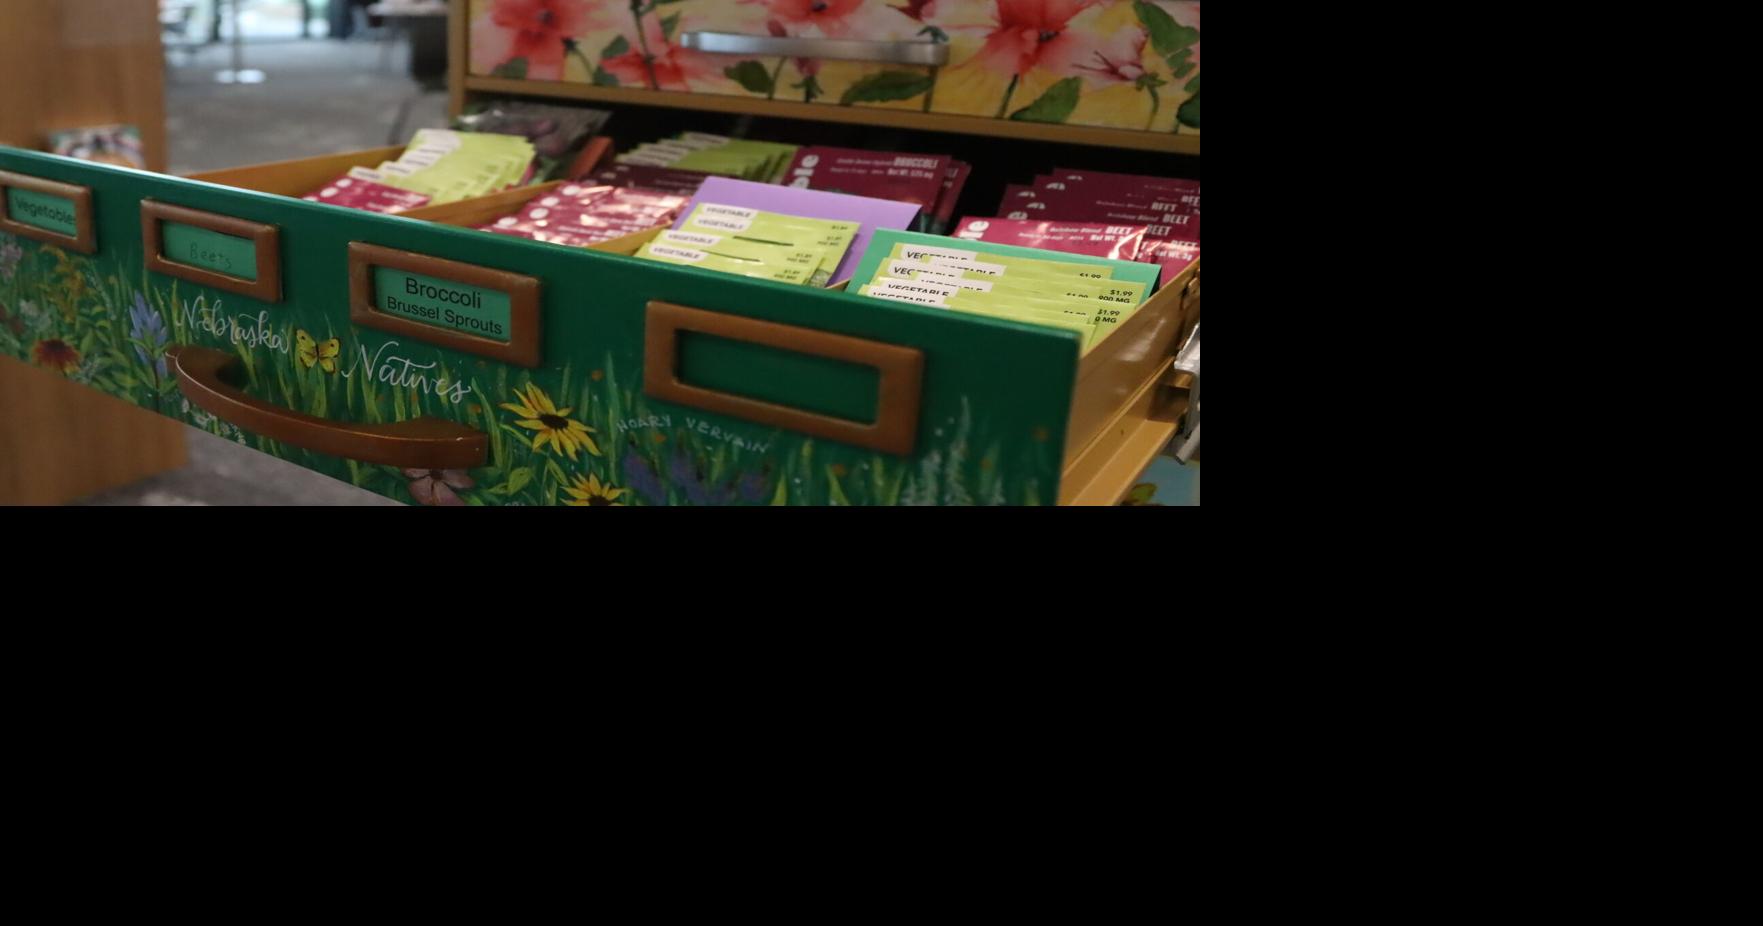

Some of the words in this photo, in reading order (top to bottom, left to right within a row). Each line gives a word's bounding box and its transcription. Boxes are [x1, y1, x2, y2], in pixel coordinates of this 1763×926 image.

[706, 207, 751, 218] VEGETABLE
[1162, 213, 1190, 225] BEET
[1105, 226, 1134, 235] BEET
[190, 242, 232, 270] Beets
[653, 247, 700, 259] VEGETABLE
[405, 277, 482, 309] Broccoli
[1110, 289, 1133, 297] $1.99
[387, 296, 440, 320] Brussel
[444, 308, 503, 335] Sprouts
[1096, 308, 1121, 317] $1.99
[1102, 316, 1117, 324] MG
[176, 295, 290, 354] Nebraska
[341, 340, 472, 405] Natives
[616, 414, 672, 433] HOARY
[685, 417, 770, 453] VERVAIN
